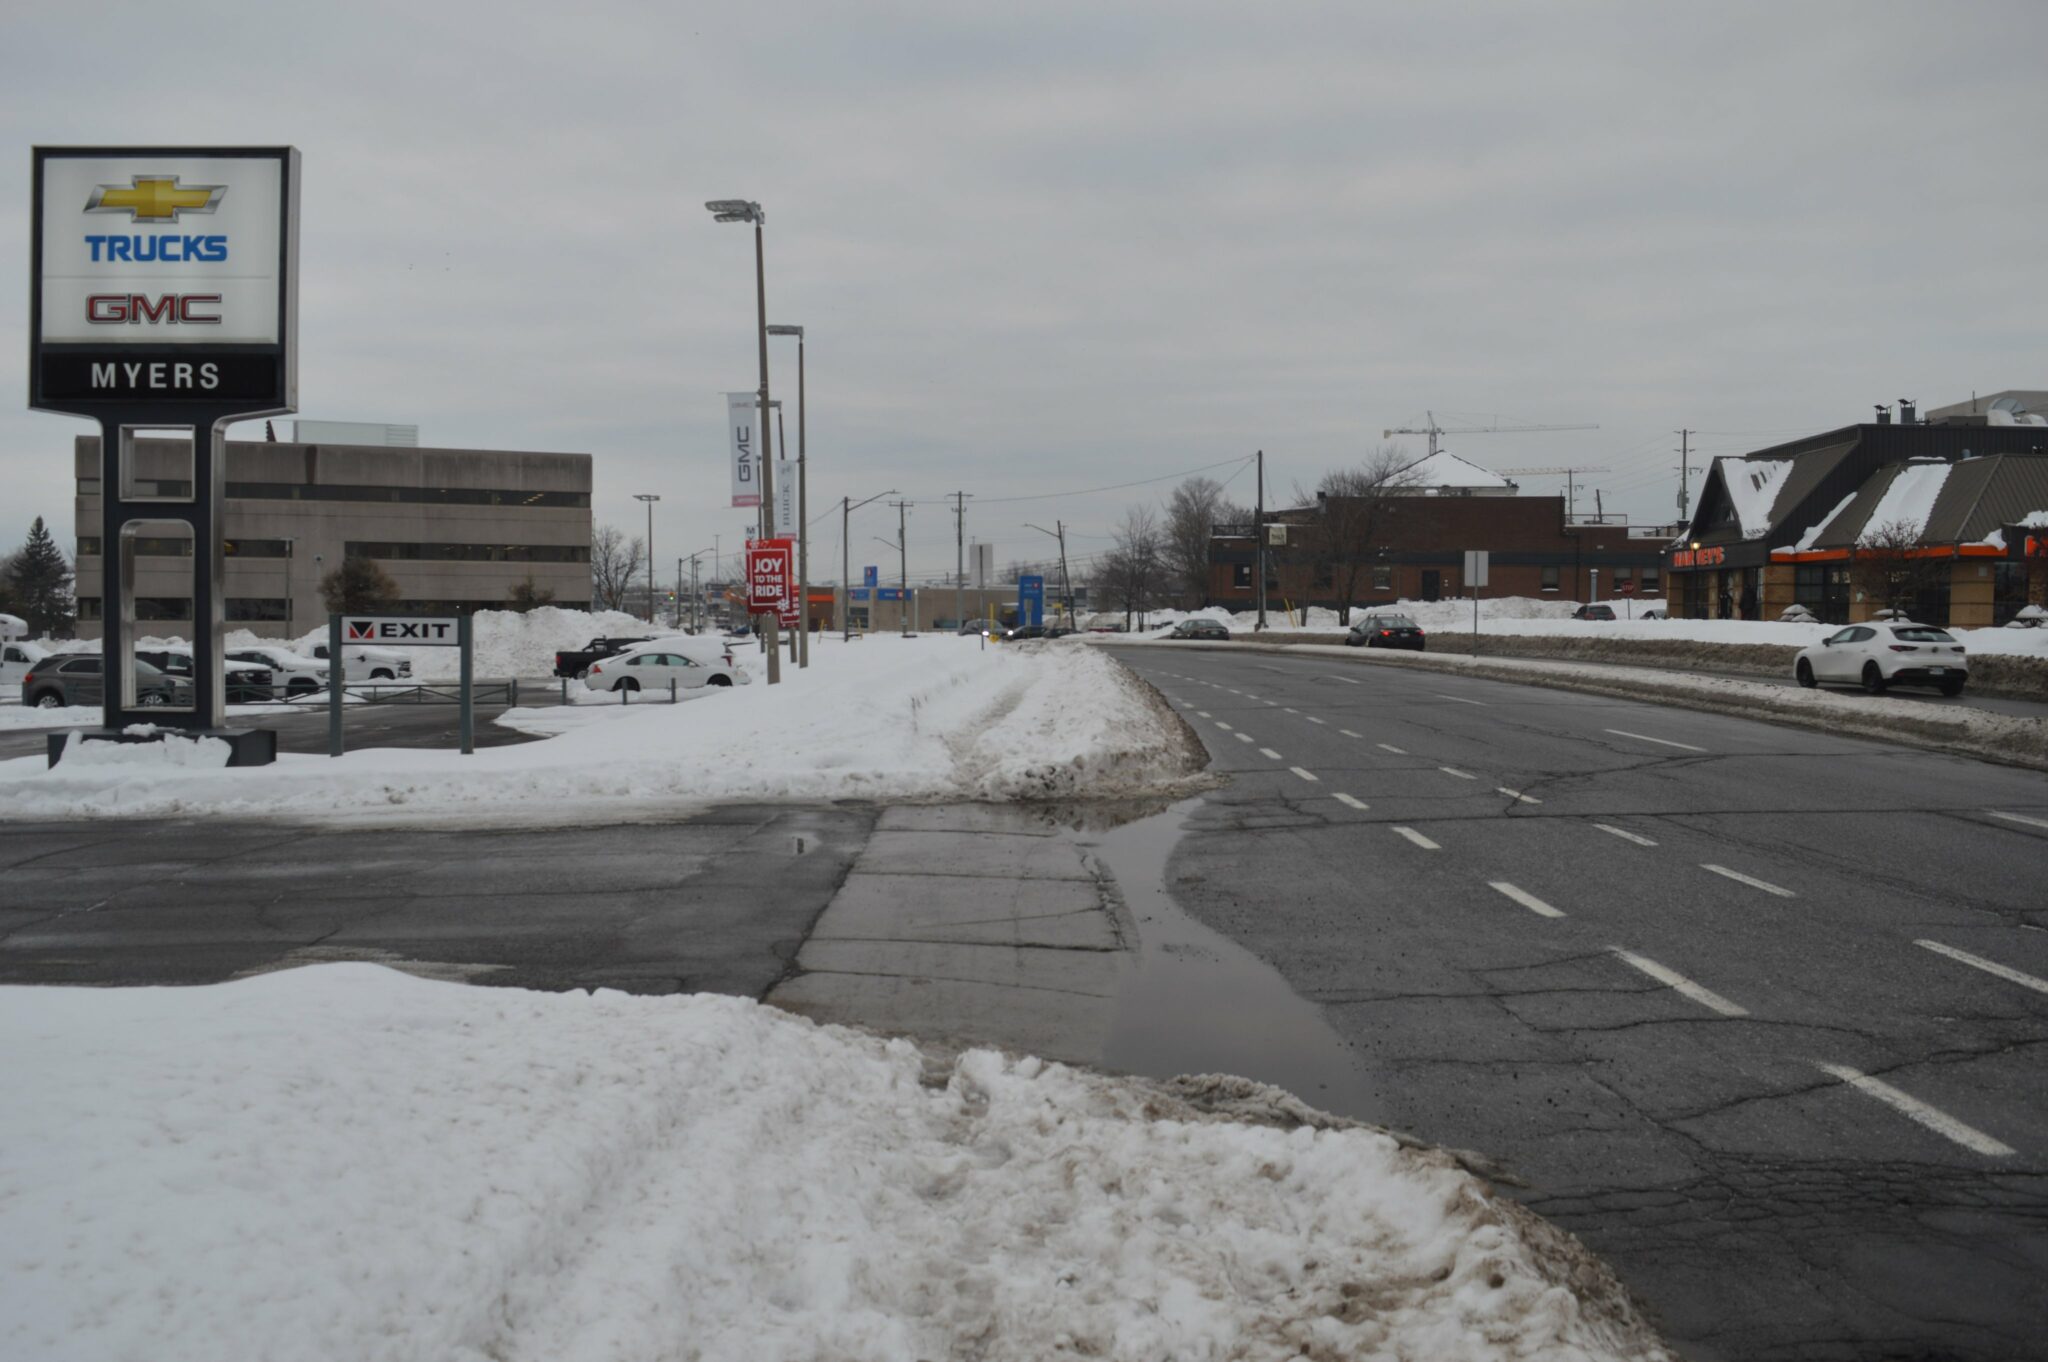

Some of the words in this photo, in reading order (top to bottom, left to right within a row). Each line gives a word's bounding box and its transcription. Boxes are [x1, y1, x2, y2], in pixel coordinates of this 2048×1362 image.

[84, 235, 228, 262] TRUCKS
[85, 293, 222, 325] GMC
[91, 362, 220, 389] MYERS
[736, 426, 751, 483] GMC
[754, 558, 783, 573] JOY
[1673, 546, 1725, 567] HARVEY'S
[755, 575, 765, 583] TO
[767, 575, 783, 583] THE
[755, 585, 783, 597] RIDE
[380, 623, 450, 638] EXIT
